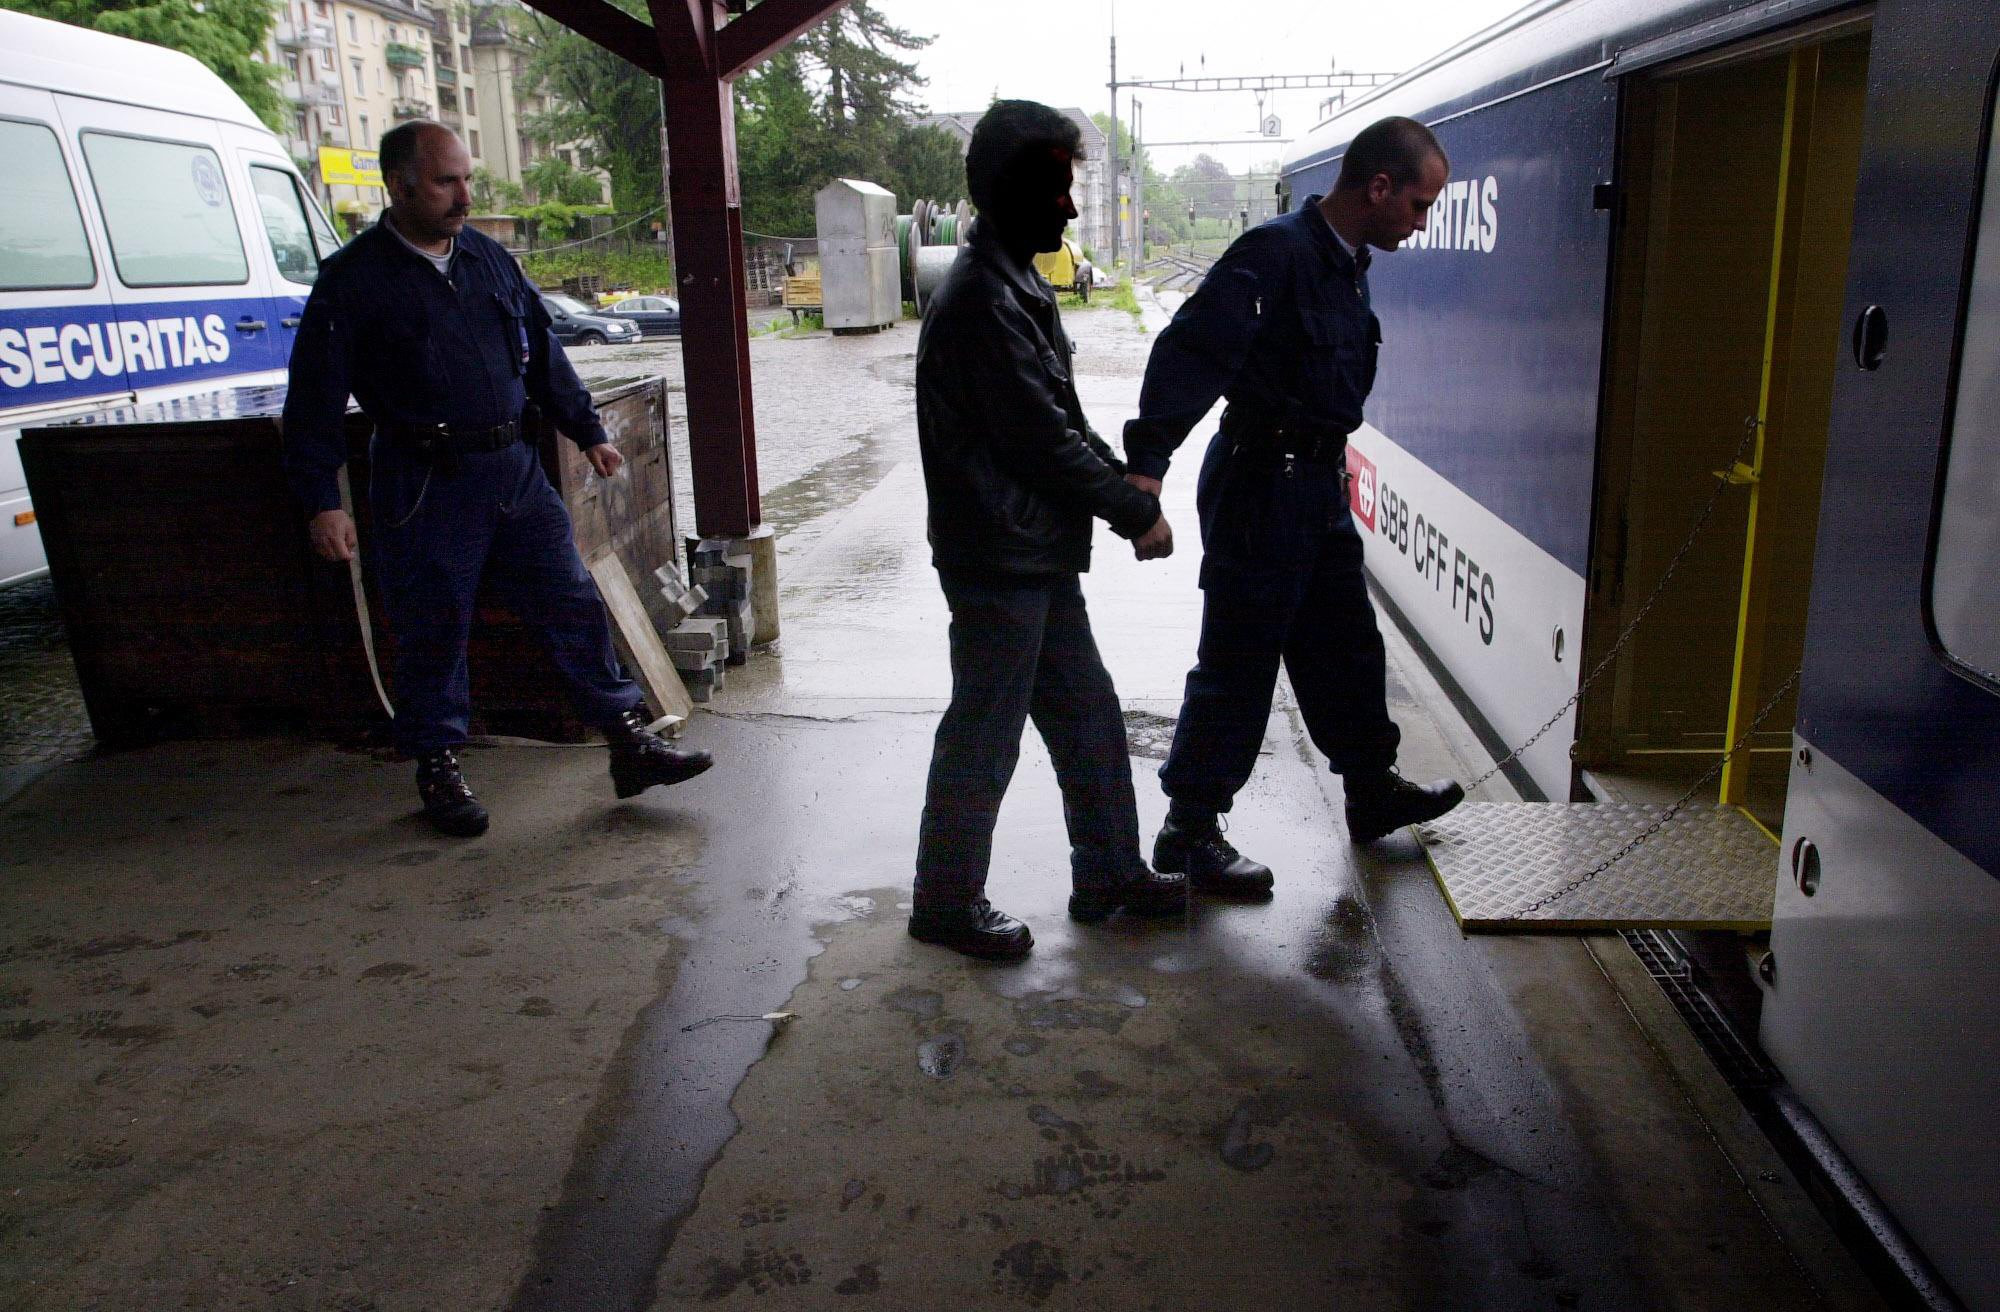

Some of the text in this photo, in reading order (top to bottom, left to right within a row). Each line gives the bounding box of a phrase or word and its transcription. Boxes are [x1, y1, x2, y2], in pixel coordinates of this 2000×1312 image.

[1268, 120, 1276, 134] 2
[0, 314, 230, 388] SECURITAS
[1380, 482, 1495, 646] SBB CFF FFS
